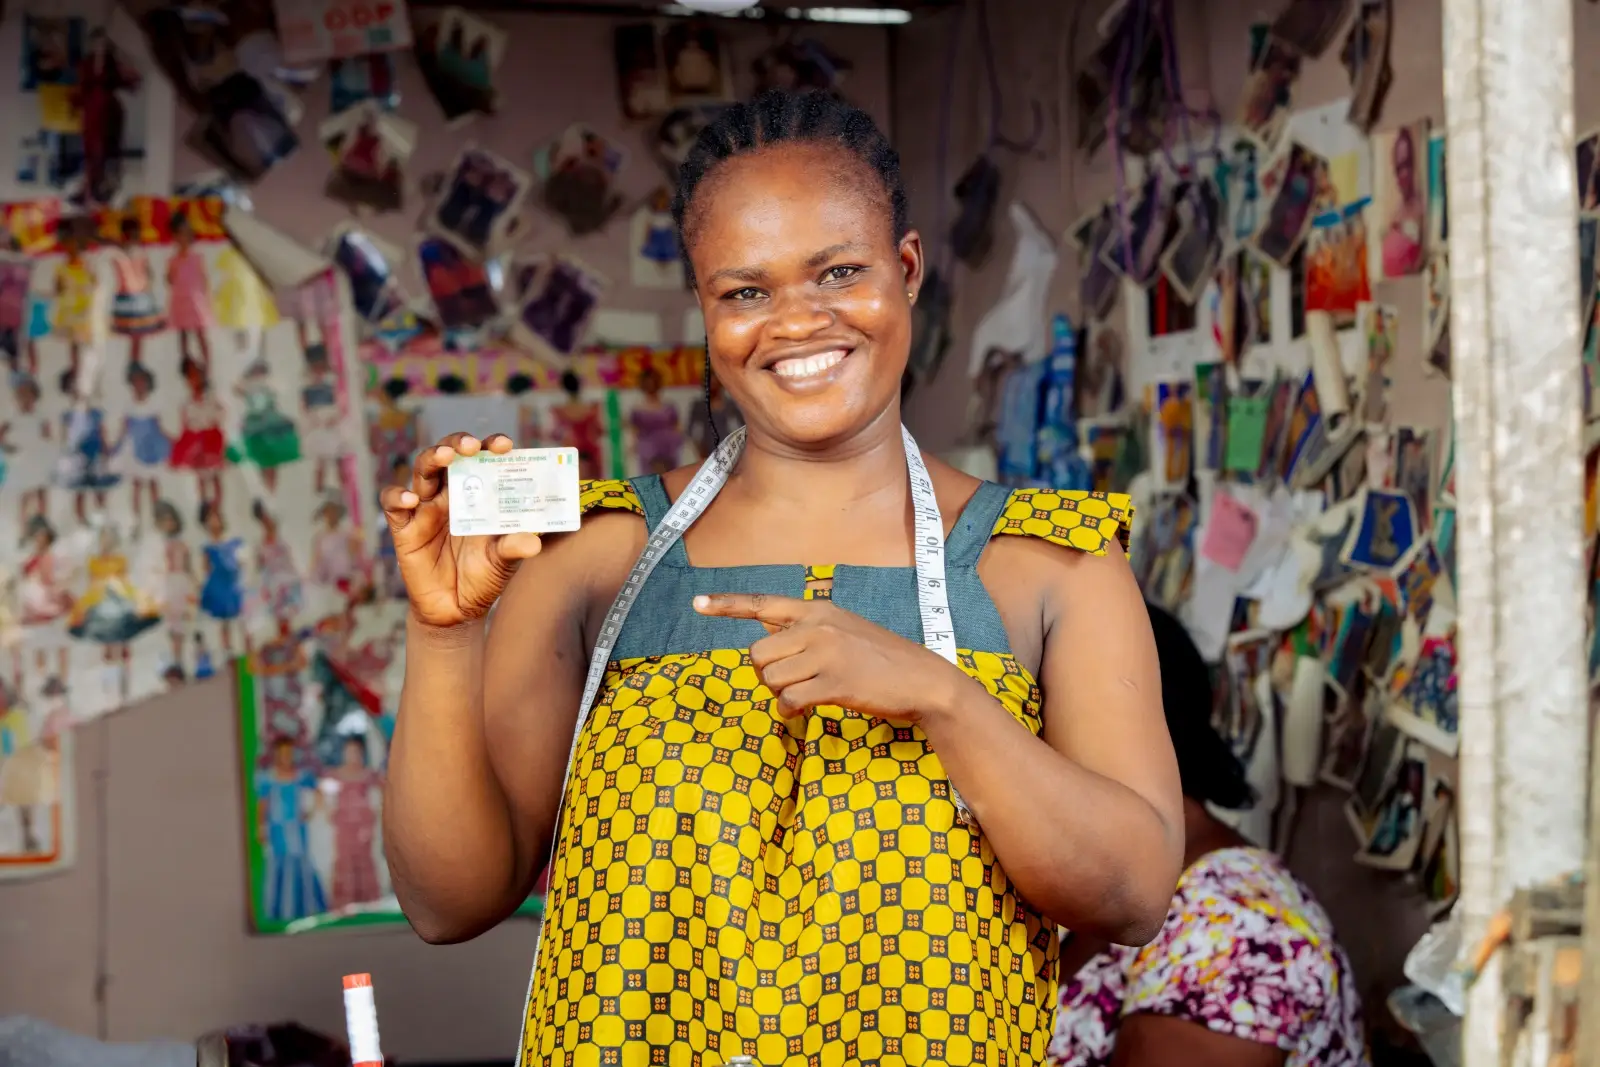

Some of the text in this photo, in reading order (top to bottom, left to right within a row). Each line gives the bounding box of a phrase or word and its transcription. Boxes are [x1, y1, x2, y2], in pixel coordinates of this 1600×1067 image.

[695, 486, 706, 495] 57
[687, 498, 697, 507] 58
[679, 509, 689, 518] 59
[925, 507, 938, 523] 11
[671, 520, 681, 529] 60
[661, 530, 672, 538] 61
[926, 536, 939, 556] 10
[927, 580, 941, 588] 9
[935, 633, 949, 641] 7
